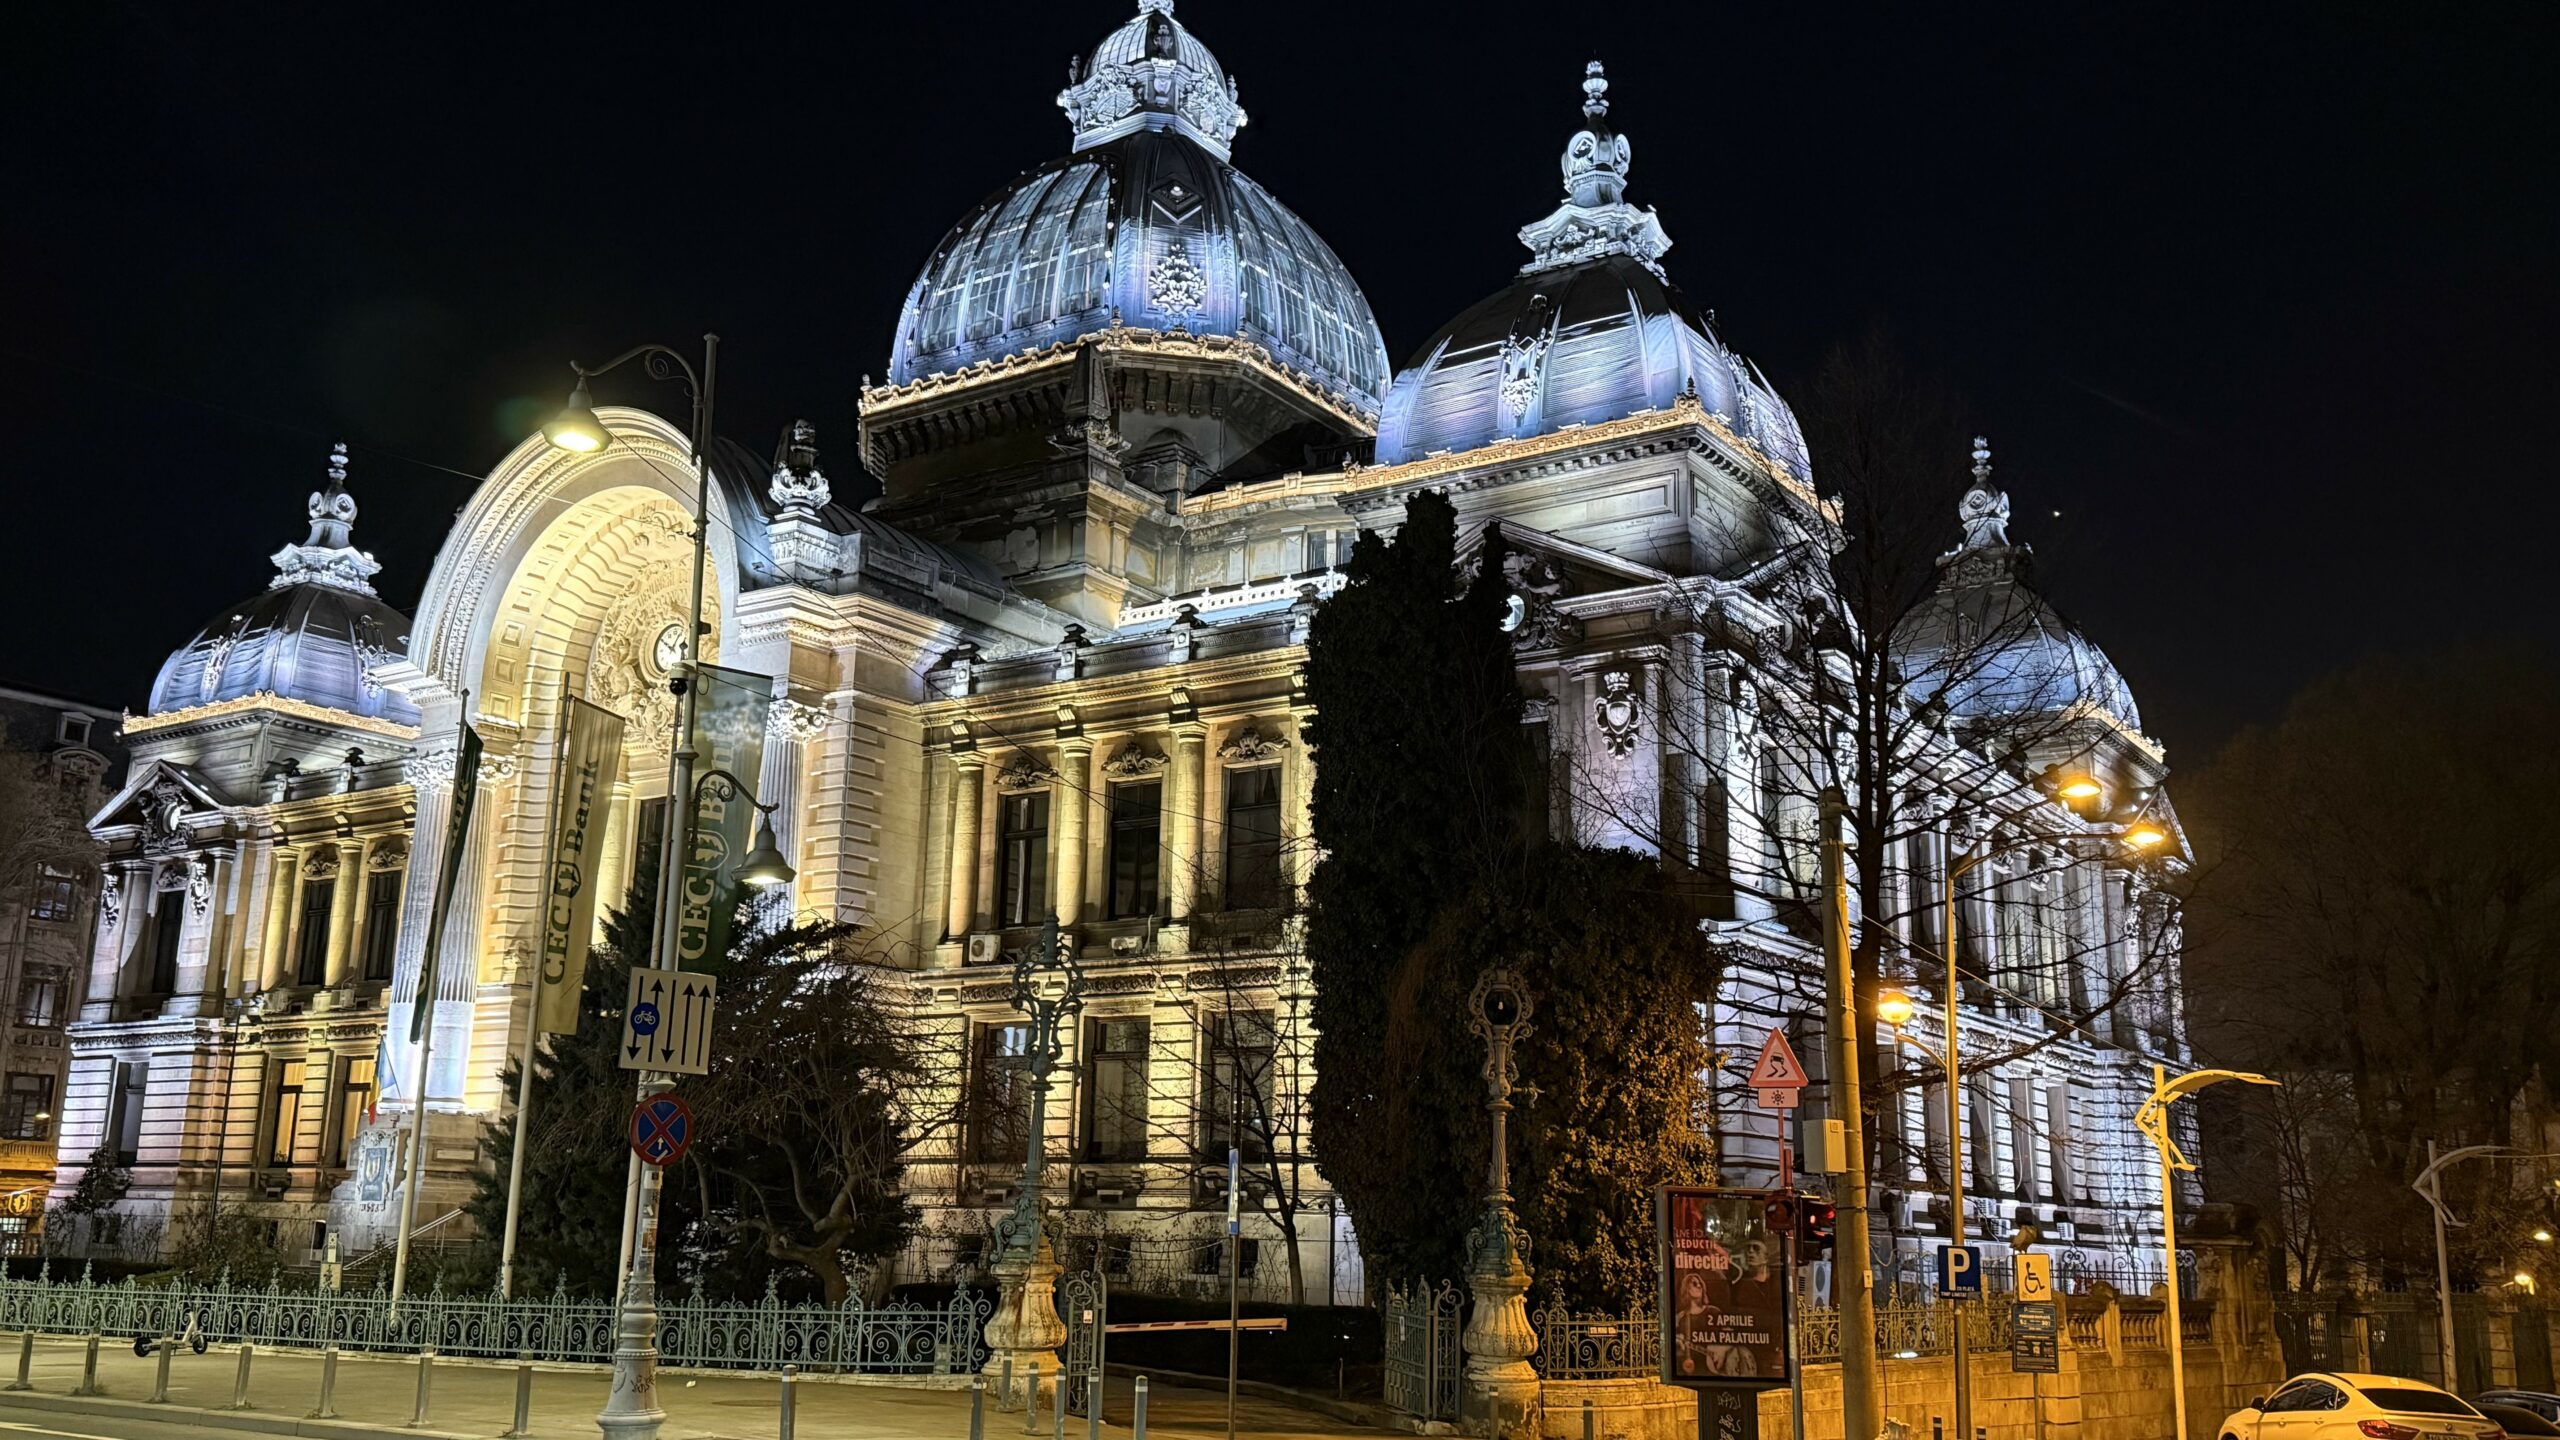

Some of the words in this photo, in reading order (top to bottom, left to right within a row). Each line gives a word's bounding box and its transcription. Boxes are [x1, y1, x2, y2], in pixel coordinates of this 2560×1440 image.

[544, 905, 572, 985] CEC
[564, 758, 599, 855] Bank
[679, 876, 714, 960] CEC
[1947, 1247, 1970, 1291] P
[1692, 1331, 1717, 1343] SALA
[1720, 1332, 1770, 1344] PALATULUI
[1707, 1315, 1714, 1326] 2
[1716, 1315, 1754, 1327] APRILIE
